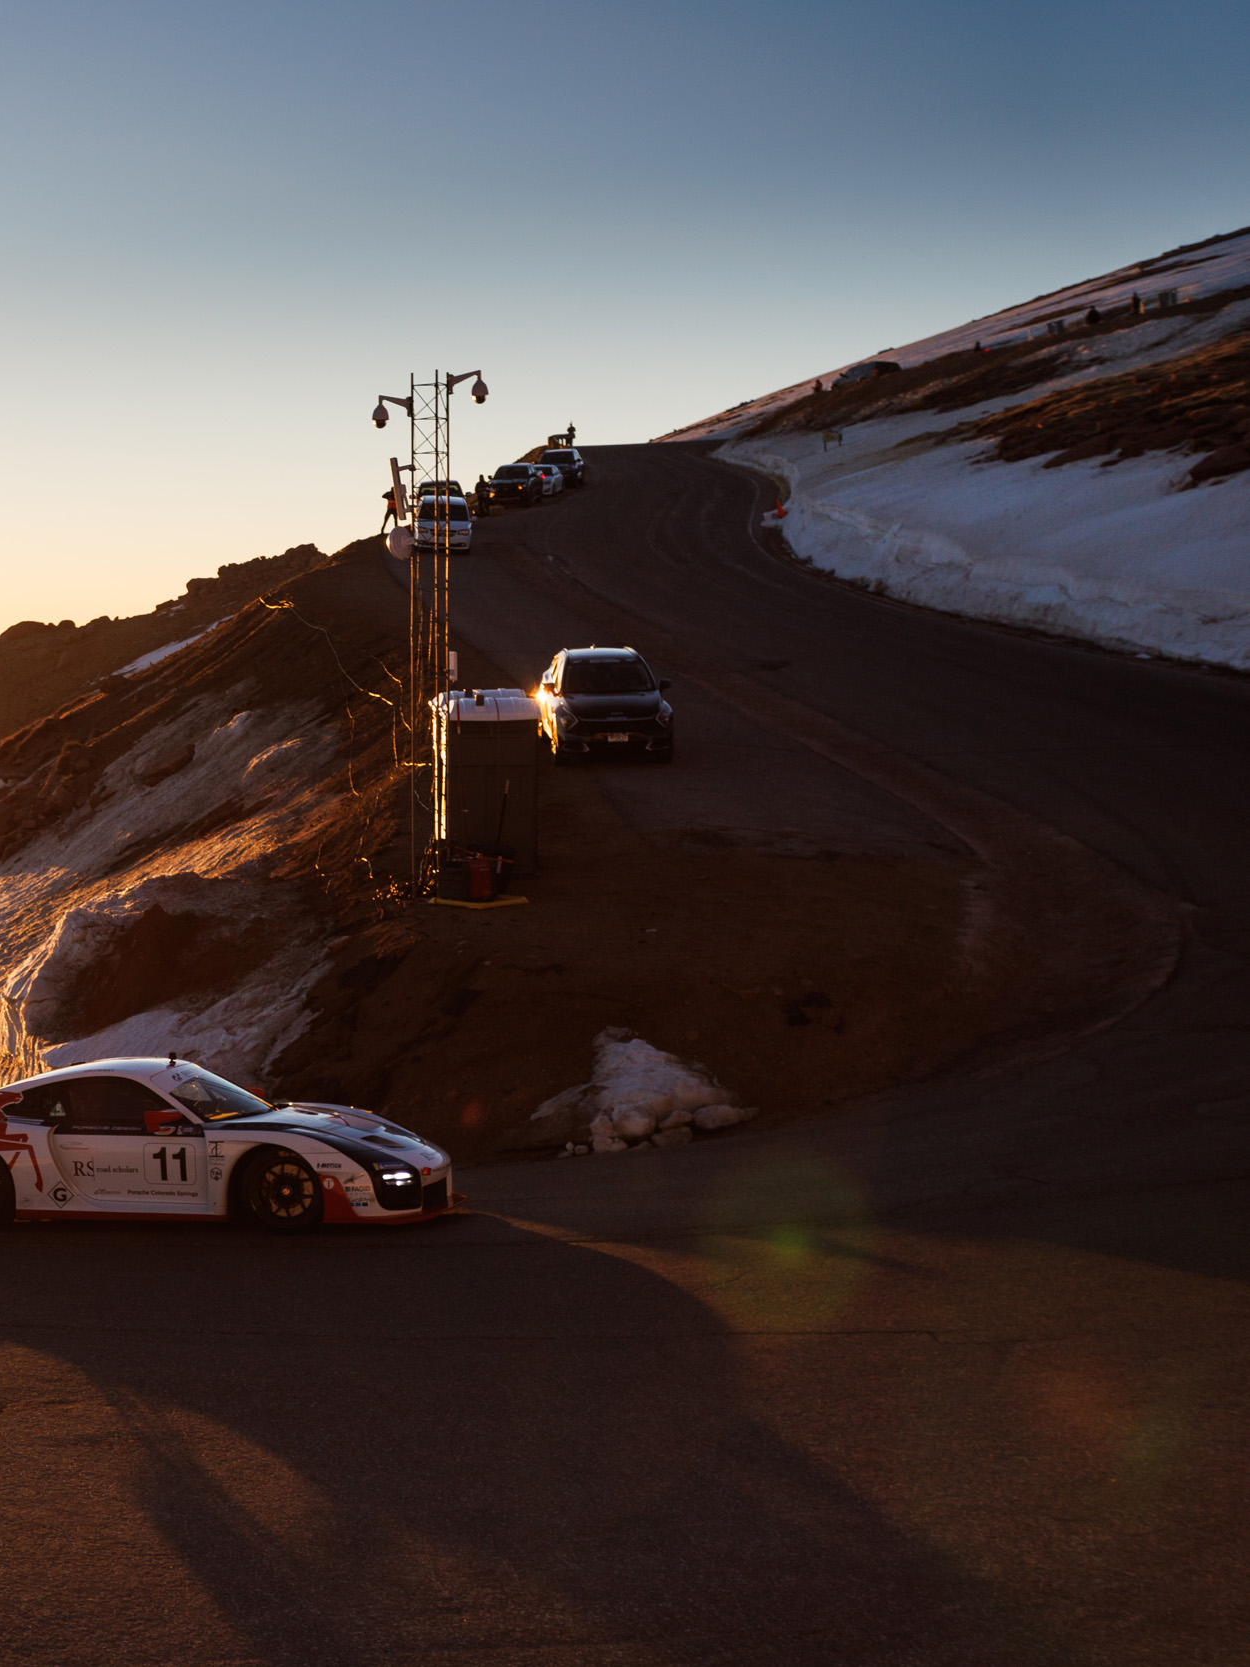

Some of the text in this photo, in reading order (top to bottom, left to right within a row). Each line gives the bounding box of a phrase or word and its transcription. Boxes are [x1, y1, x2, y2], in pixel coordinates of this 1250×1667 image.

[73, 1160, 139, 1178] RS road scholars
[152, 1146, 188, 1182] 11
[53, 1187, 68, 1203] G
[177, 1190, 199, 1198] Springs
